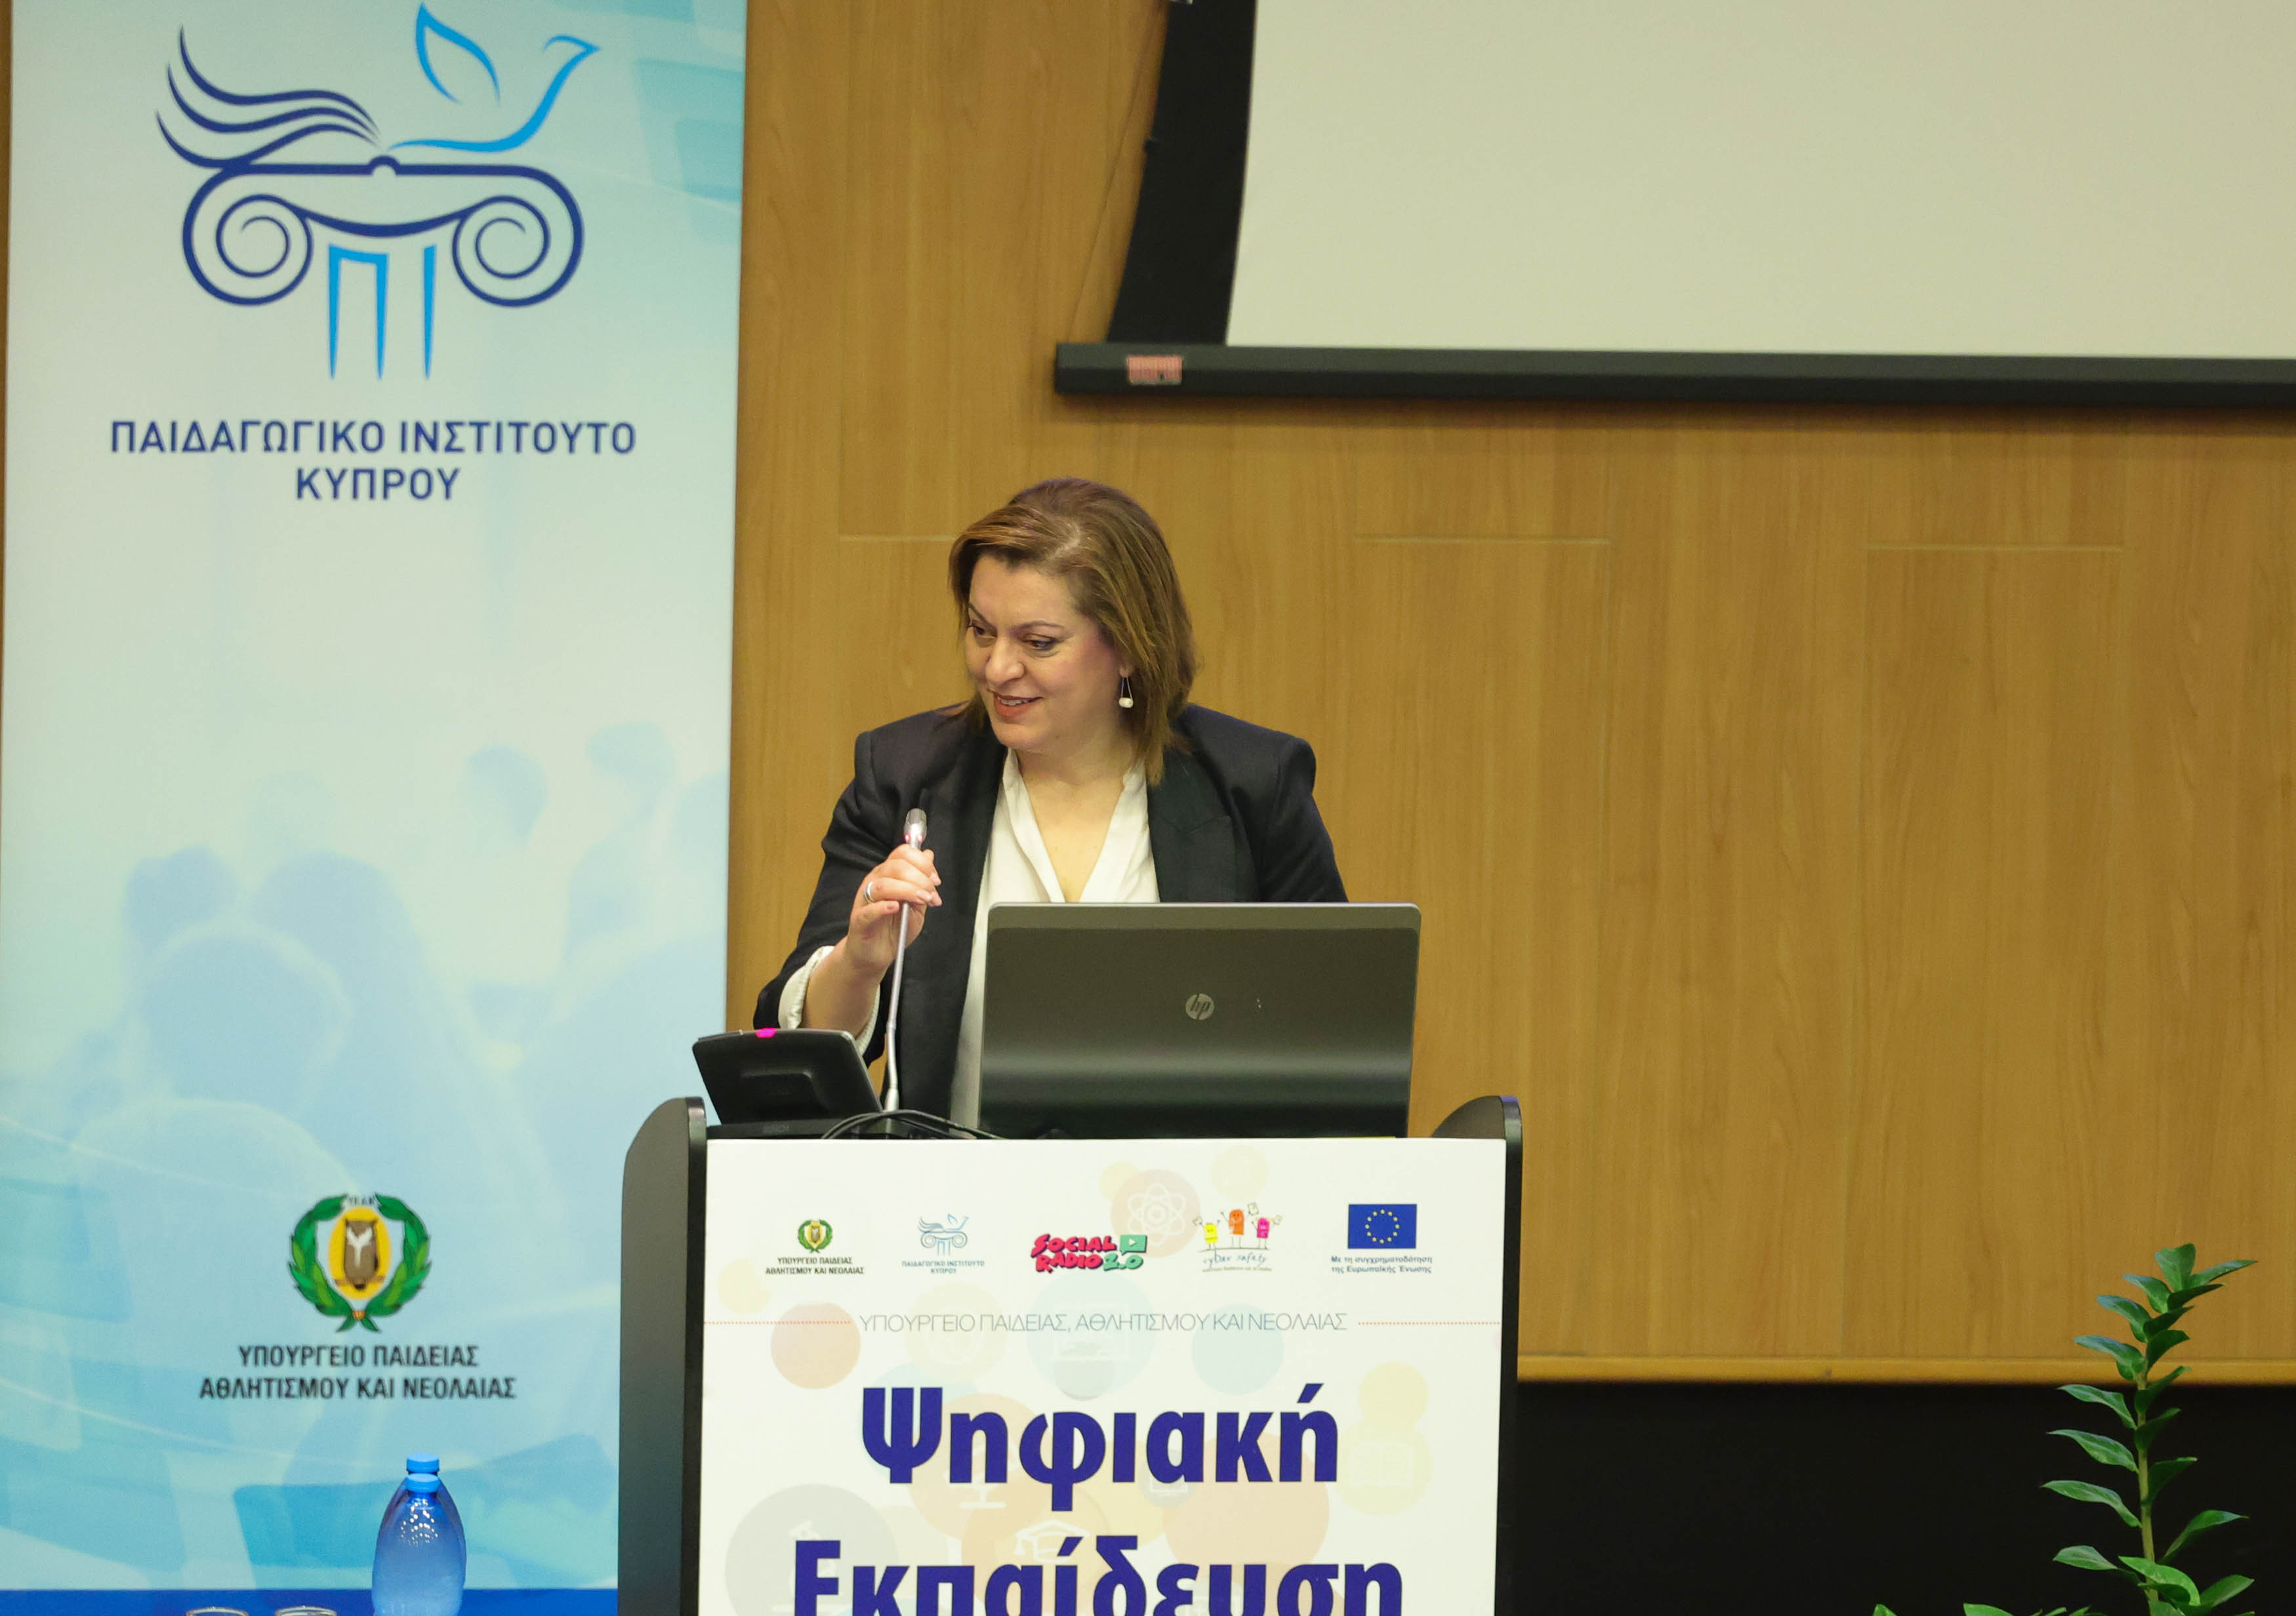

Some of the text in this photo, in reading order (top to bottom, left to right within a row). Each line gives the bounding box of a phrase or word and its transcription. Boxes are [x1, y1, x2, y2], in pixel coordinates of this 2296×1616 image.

[112, 420, 636, 455] ΠΑΙΔΑΓΩΓΙΚΟ ΙΝΣΤΙΤΟΥΤΟ
[297, 468, 460, 500] ΚΥΠΡΟΥ
[1188, 993, 1213, 1020] hp
[1031, 1234, 1117, 1258] SOCIAL
[1035, 1251, 1144, 1274] RADIO 2.0
[859, 1312, 1349, 1333] ΥΠΟΥΡΓΕΙΟ ΠΑΙΔΕΙΑΣ, ΑΘΛΗΤΙΣΜΟΥ ΚΑΙ ΝΕΟΛΑΙΑΣ
[238, 1345, 479, 1367] ΥΠΟΥΡΓΕΙΟ ΠΑΙΔΕΙΑΣ
[199, 1377, 517, 1400] ΑΘΛΗΤΙΣΜΟΥ ΚΑΙ ΝΕΟΛΑΙΑΣ
[862, 1383, 1338, 1512] Ψηφιακή
[794, 1535, 1403, 1616] Εκπαίδευση
